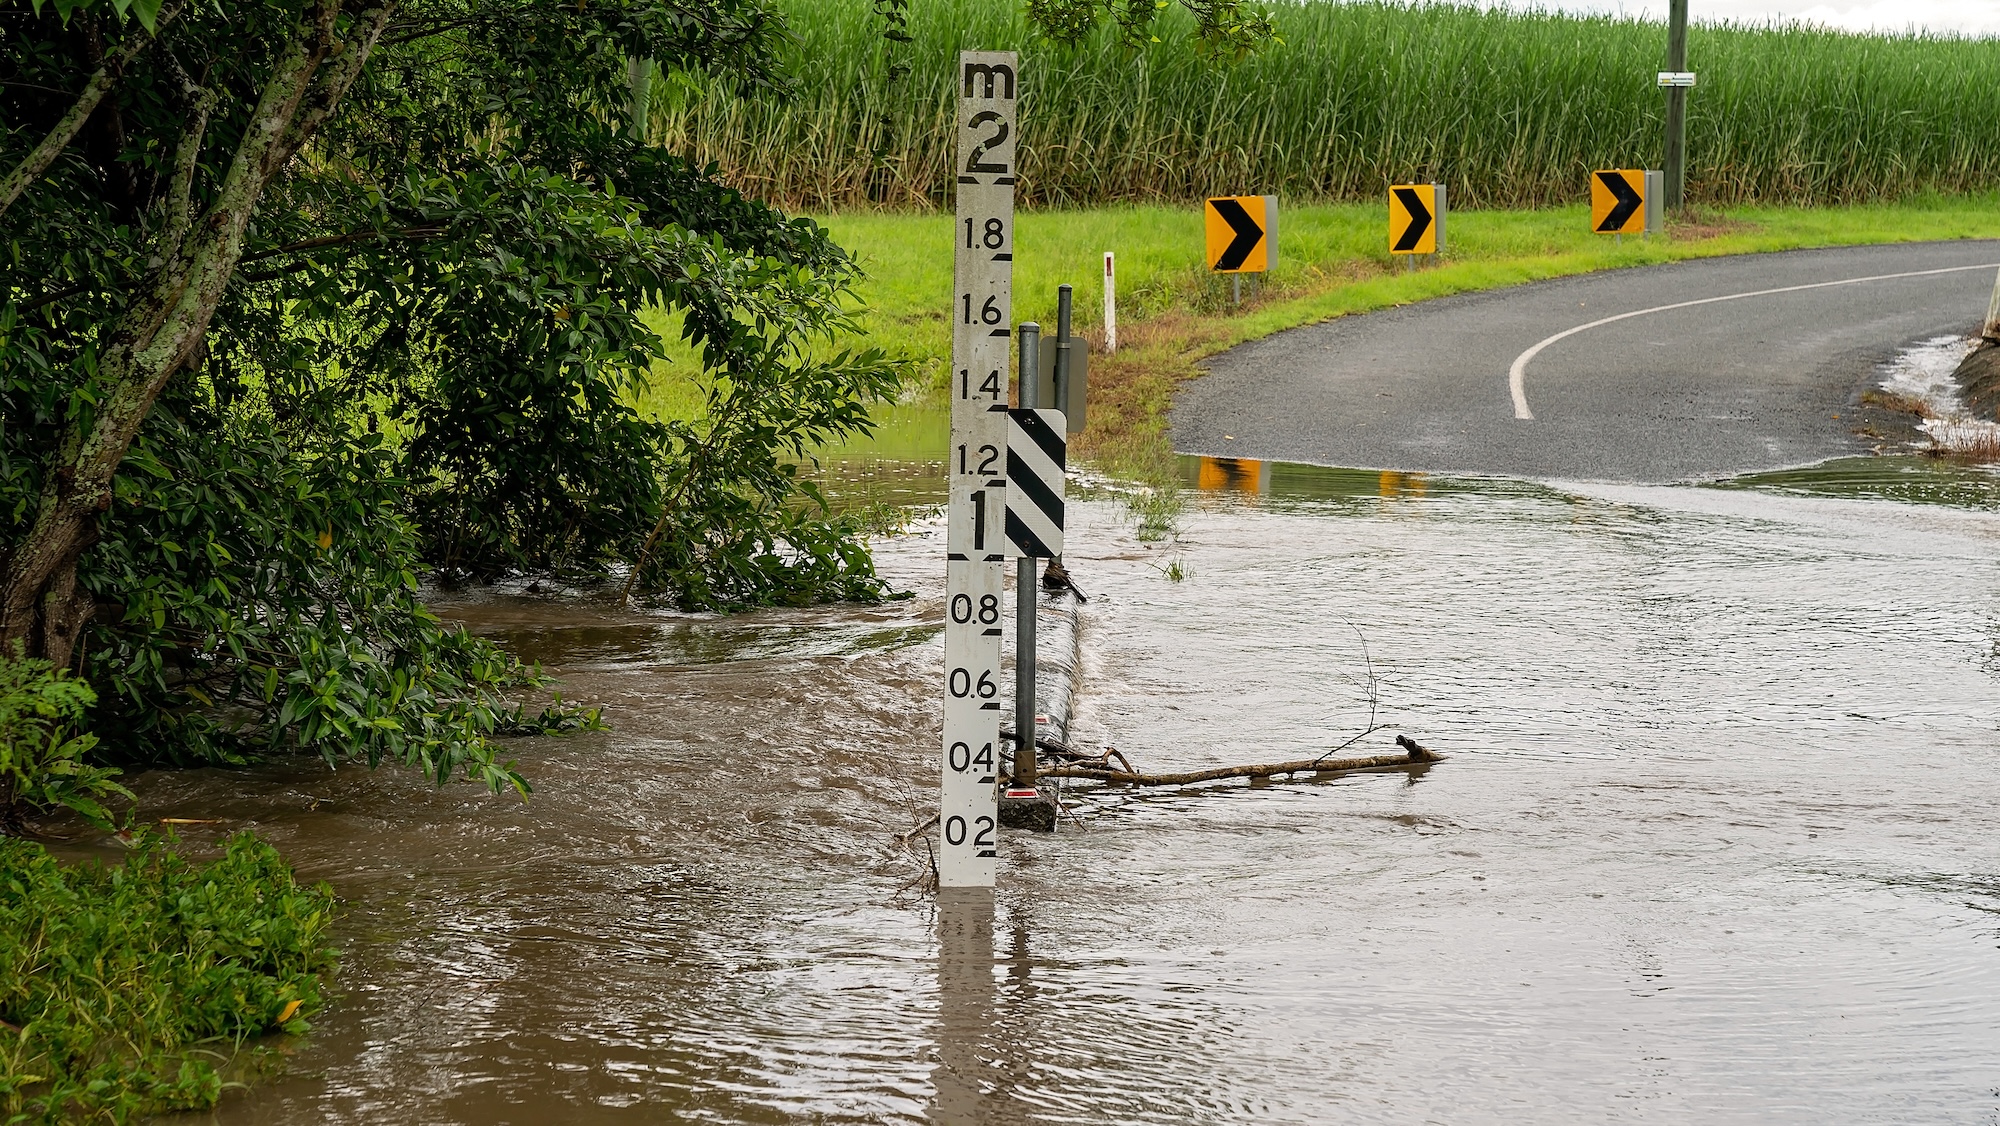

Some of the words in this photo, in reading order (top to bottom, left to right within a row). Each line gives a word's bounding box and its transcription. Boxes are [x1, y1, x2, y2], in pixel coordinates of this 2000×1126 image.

[963, 62, 1015, 100] m
[965, 110, 1009, 174] 2
[964, 217, 1004, 250] 1.8
[962, 293, 1002, 326] 1.6
[959, 368, 1001, 401] 1.4
[957, 442, 999, 477] 1.2
[970, 488, 986, 551] 1
[950, 593, 999, 625] 0.8
[949, 667, 997, 699] 0.6
[948, 741, 994, 773] 0.4
